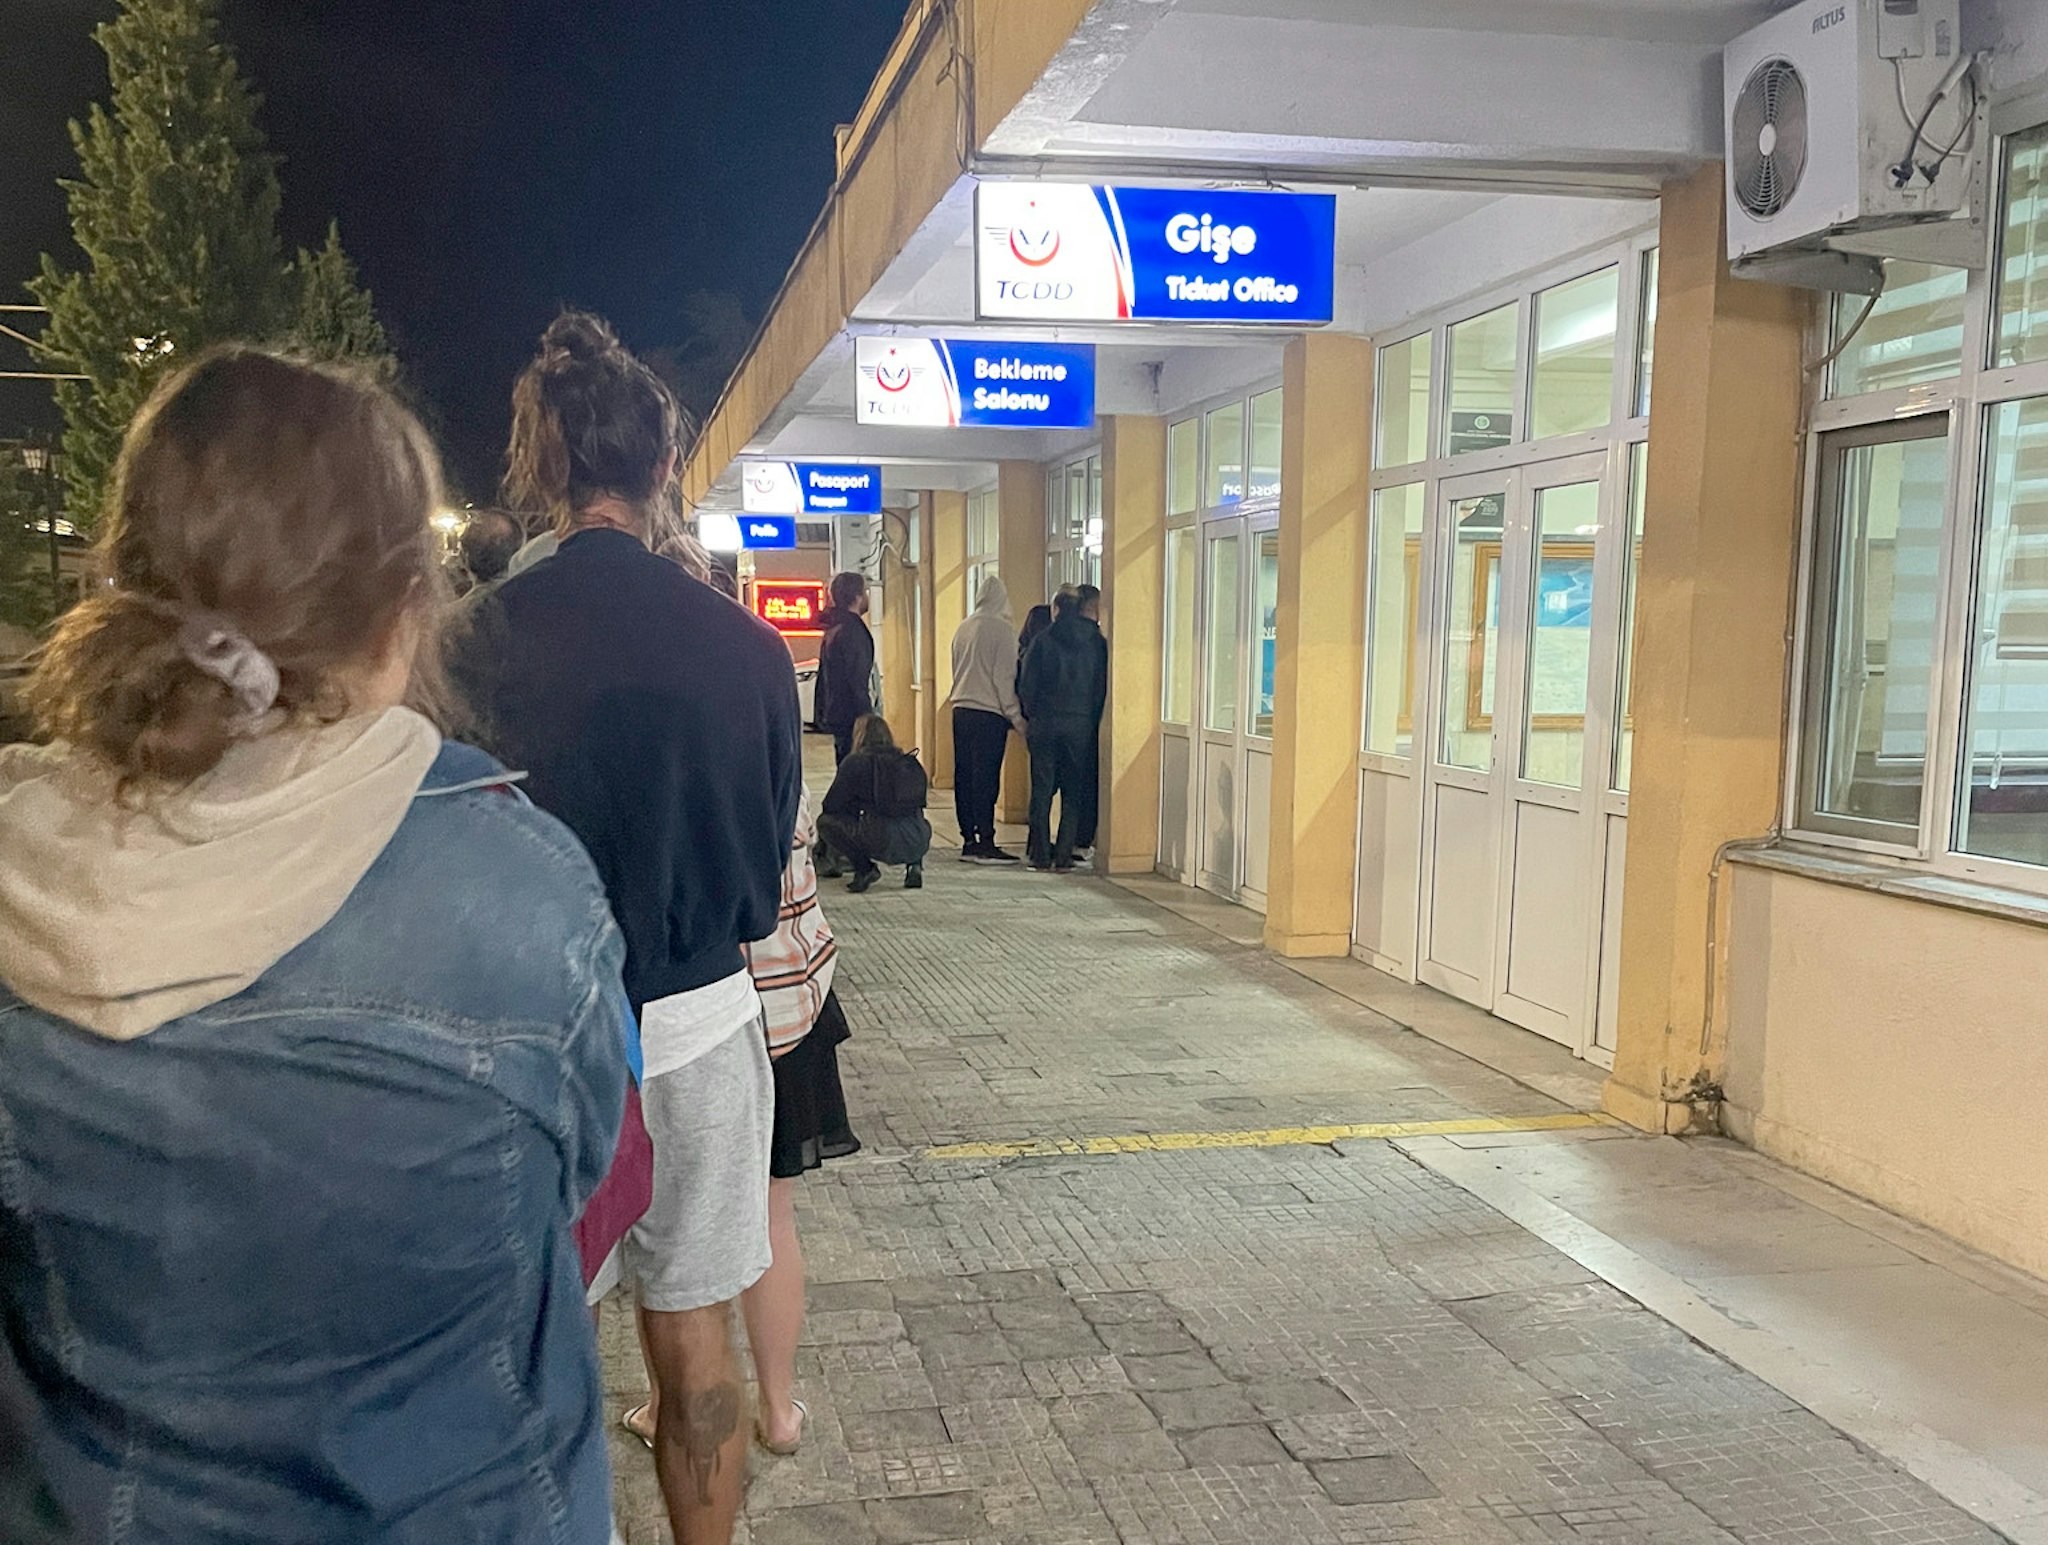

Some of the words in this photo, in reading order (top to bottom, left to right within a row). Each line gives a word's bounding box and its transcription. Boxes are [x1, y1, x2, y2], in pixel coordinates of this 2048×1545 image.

[1812, 6, 1845, 34] ALTUS
[1165, 213, 1257, 264] Gişe
[996, 280, 1073, 300] TCDD
[1165, 275, 1230, 301] Ticket
[1233, 276, 1299, 303] Office
[974, 358, 1067, 381] Bekleme
[973, 387, 1050, 411] Salonu
[810, 472, 869, 491] Pasaport
